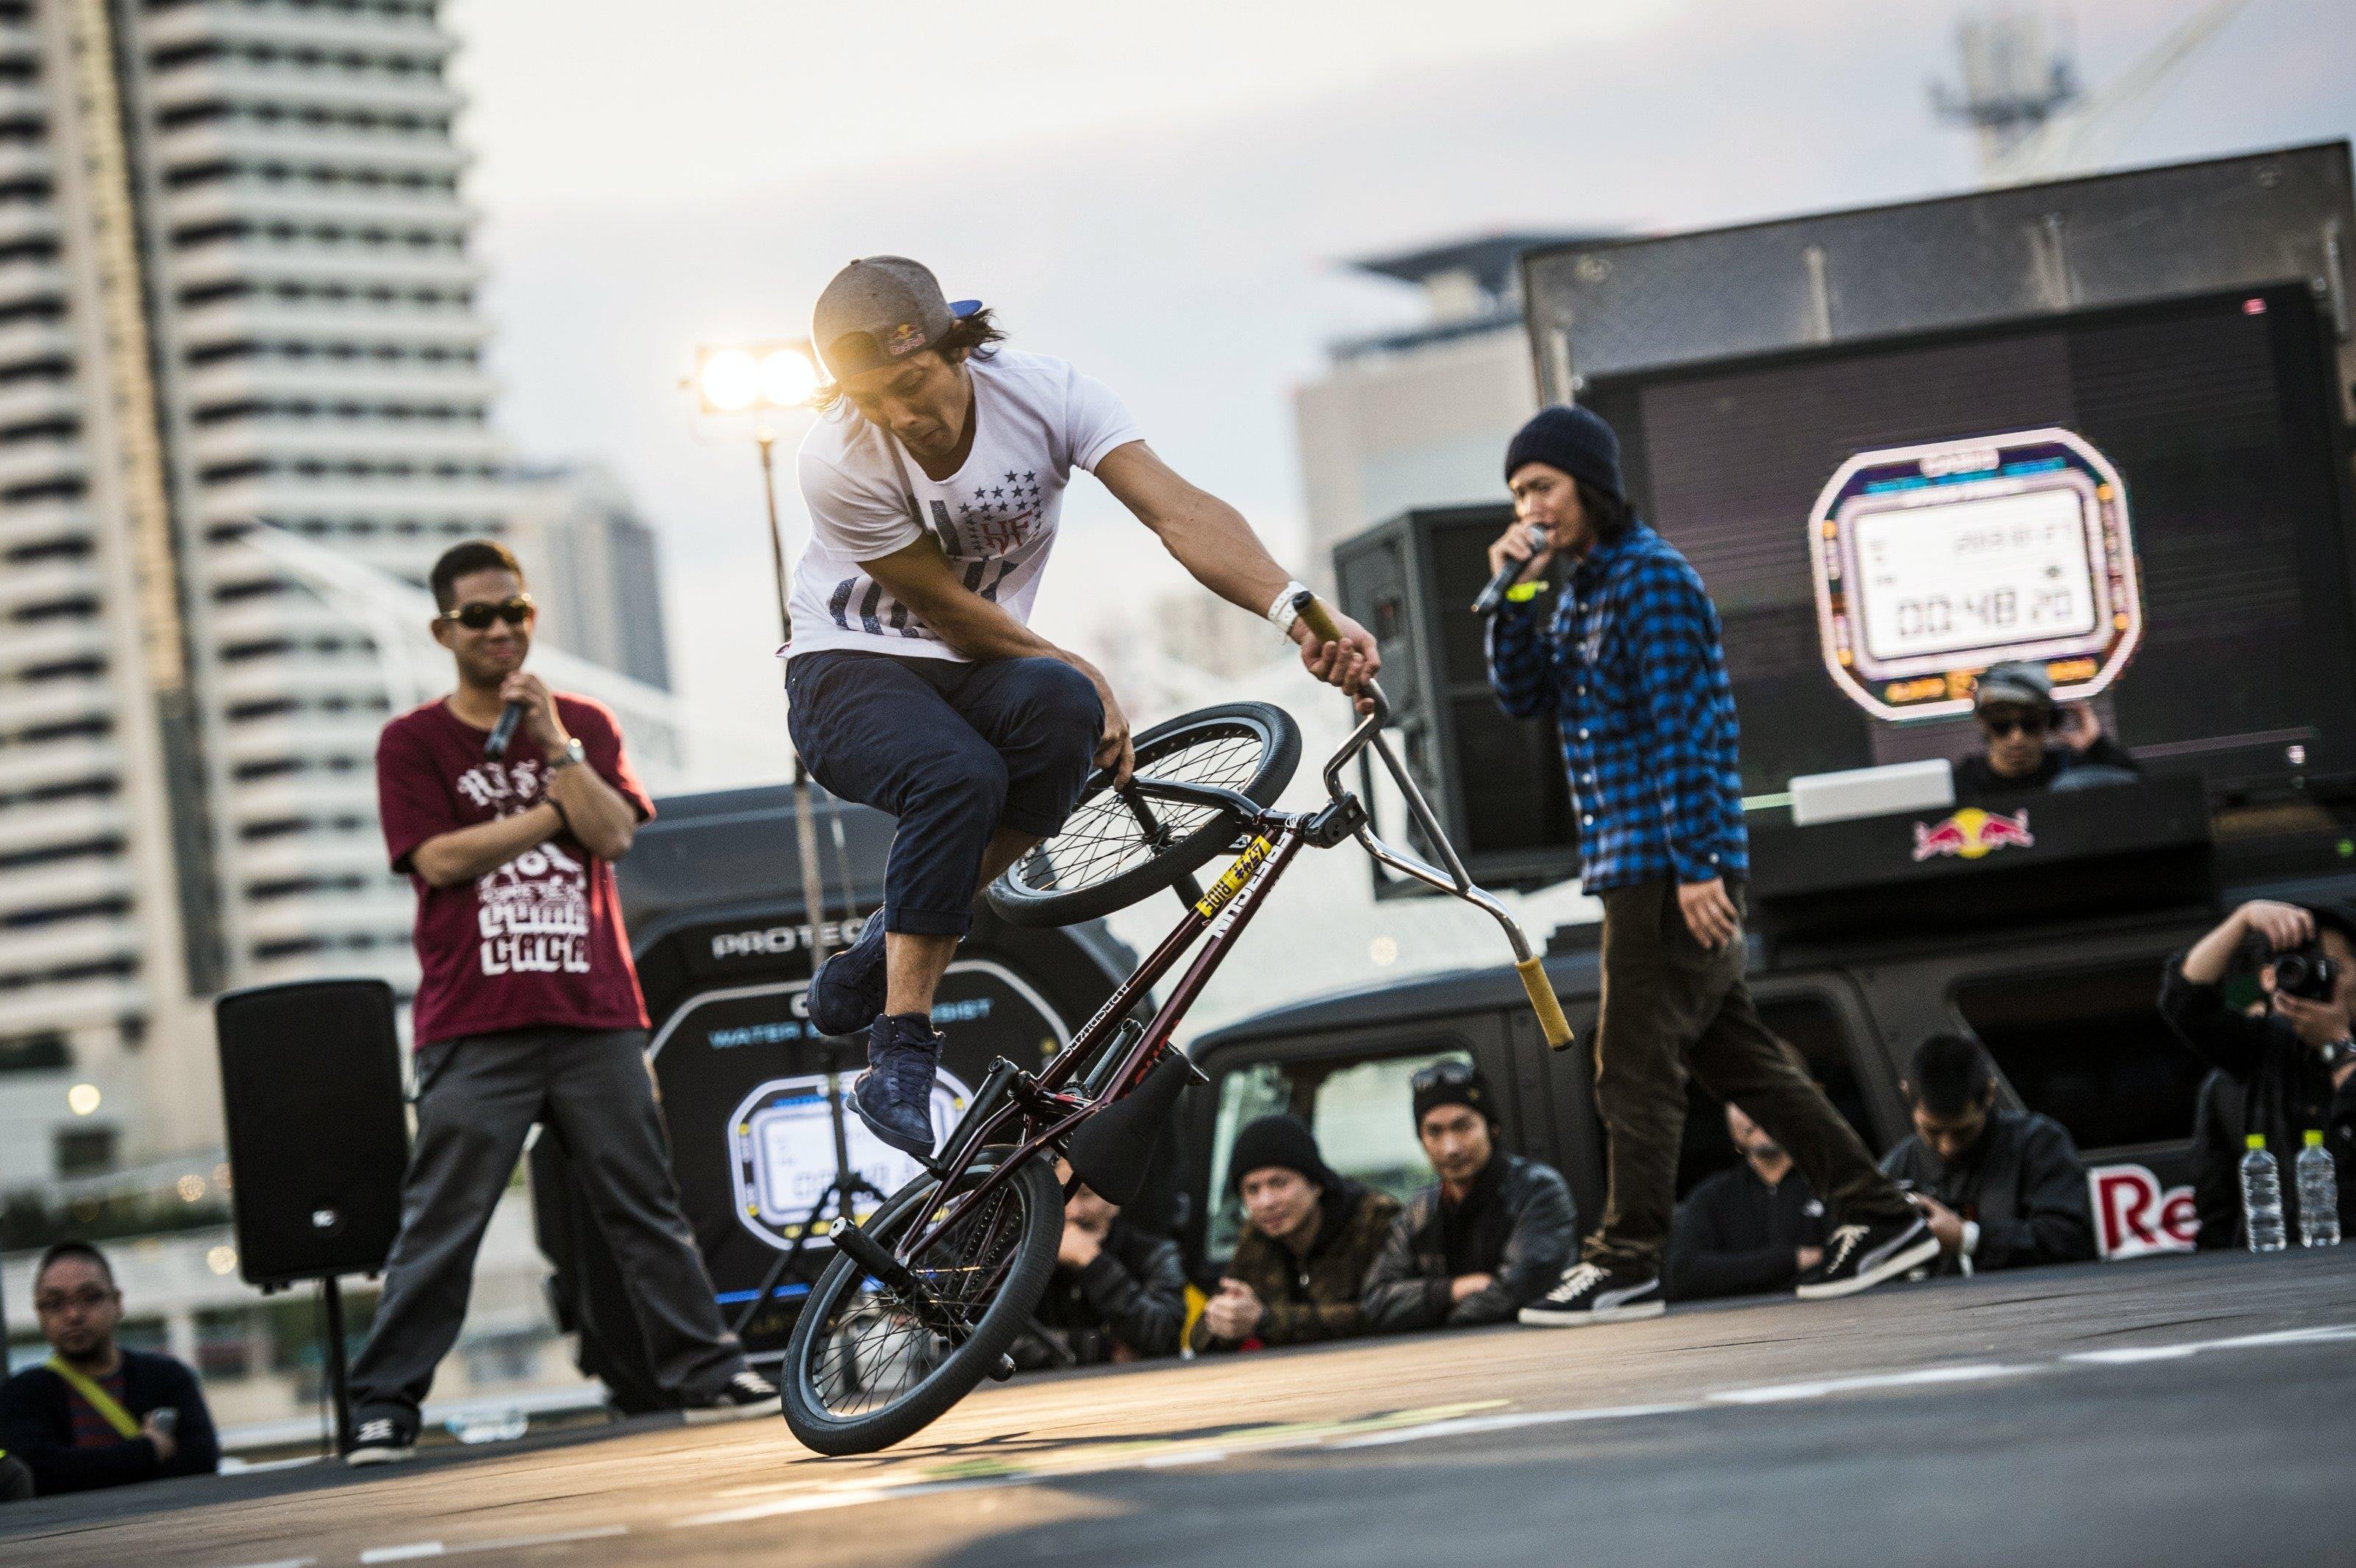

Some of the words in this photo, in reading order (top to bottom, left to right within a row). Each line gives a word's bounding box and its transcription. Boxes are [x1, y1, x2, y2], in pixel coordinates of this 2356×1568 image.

[1200, 880, 1232, 914] RIDE
[711, 918, 866, 959] PROTEC
[2097, 1173, 2200, 1251] Re
